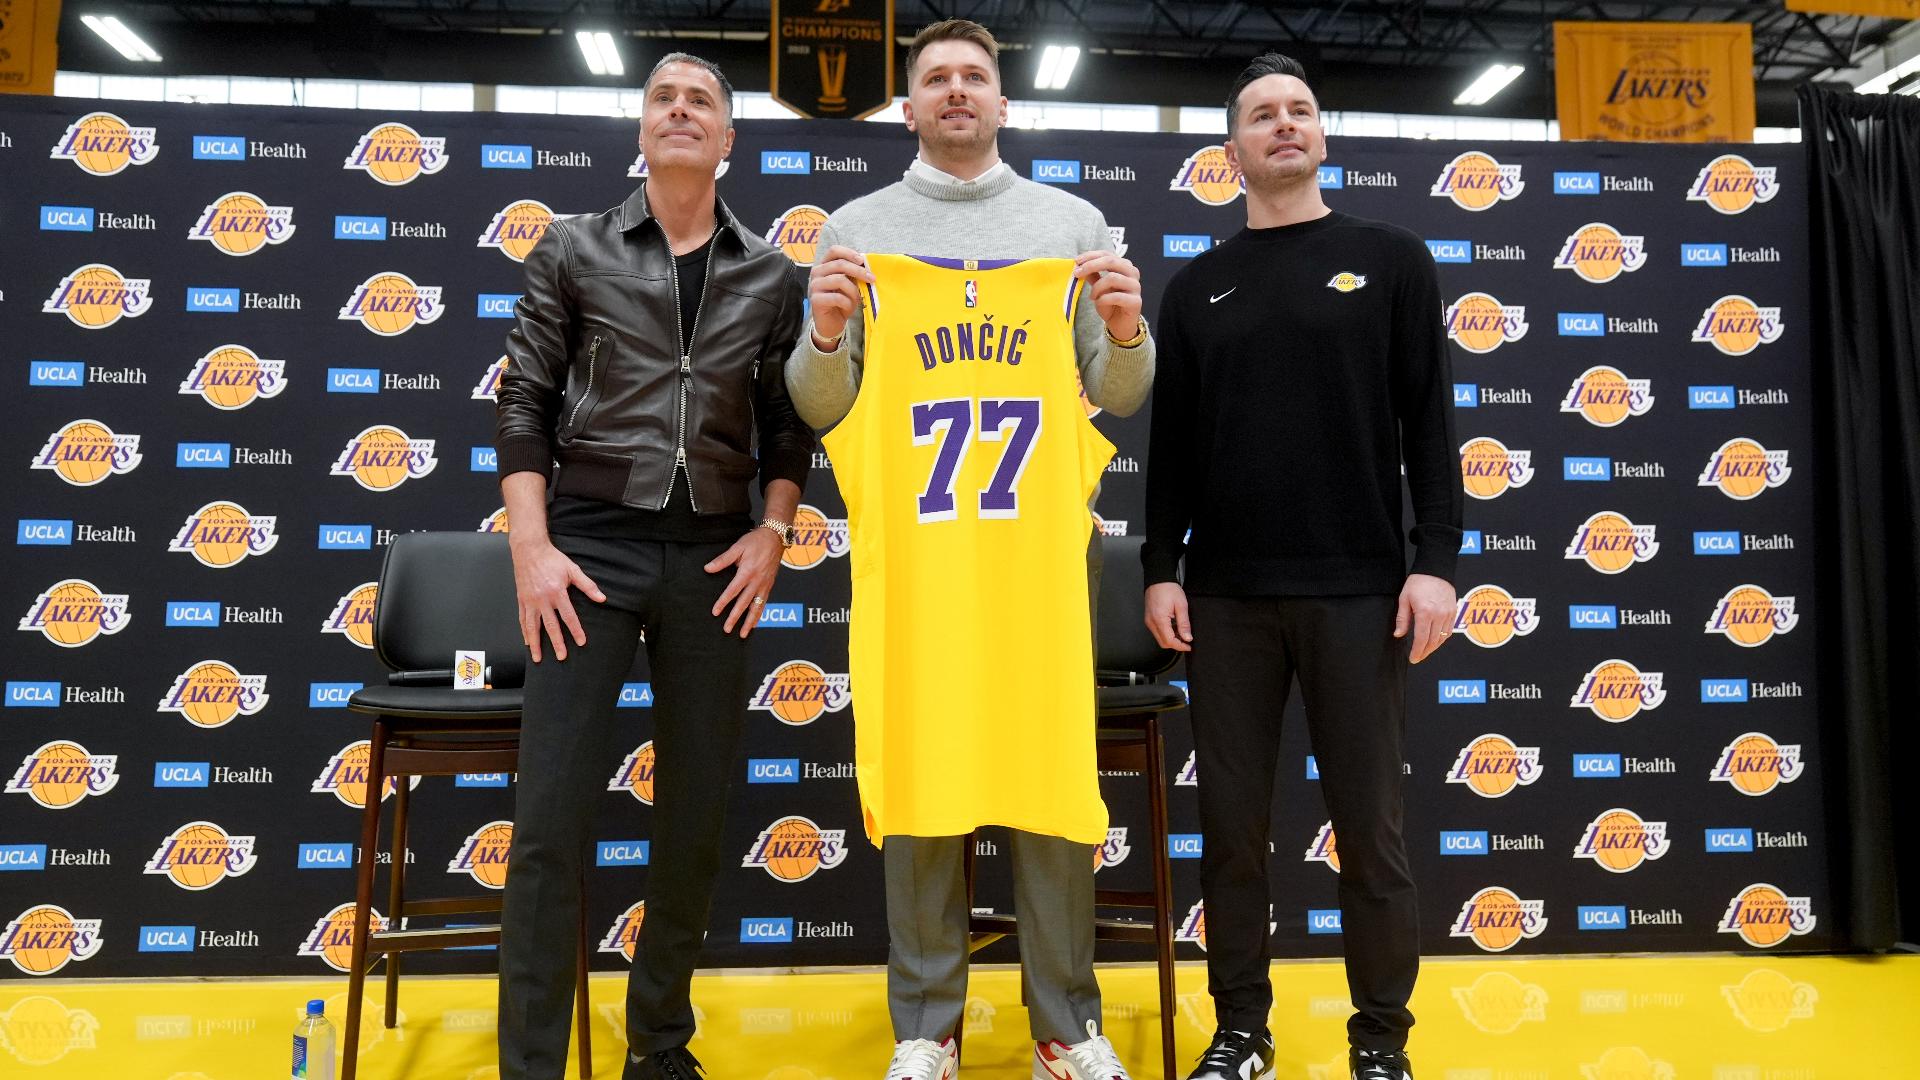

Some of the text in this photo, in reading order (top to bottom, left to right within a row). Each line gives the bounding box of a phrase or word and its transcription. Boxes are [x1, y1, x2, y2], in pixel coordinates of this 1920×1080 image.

[782, 24, 882, 41] CHAMPIONS
[1606, 69, 1710, 109] LAKERS
[61, 128, 150, 161] LAKERS
[201, 142, 306, 158] UCLA Health
[354, 138, 440, 170] LAKERS
[489, 151, 591, 167] UCLA Health
[768, 156, 867, 172] UCLA Health
[1039, 165, 1135, 180] UCLA Health
[1180, 161, 1245, 188] LAKER
[1347, 171, 1397, 186] Health
[1440, 167, 1516, 196] LAKERS
[1560, 176, 1653, 191] UCLA Health
[1695, 171, 1771, 198] LAKERS
[48, 213, 155, 229] UCLA Health
[198, 208, 286, 240] LAKERS
[342, 222, 446, 237] UCLA Health
[488, 216, 546, 244] LAKE
[771, 221, 819, 246] LAKE
[1170, 241, 1205, 253] UCLA
[1432, 245, 1525, 260] UCLA Health
[1562, 239, 1638, 268] LAKERS
[1688, 248, 1779, 262] UCLA Health
[53, 280, 144, 313] LAKERS
[194, 293, 300, 309] UCLA Health
[349, 288, 436, 320] LAKERS
[485, 300, 513, 312] UCL
[1447, 308, 1519, 338] LAKERS
[1565, 318, 1658, 333] UCLA Health
[1700, 311, 1775, 339] LAKERS
[914, 313, 1031, 371] DONČIĆ
[38, 367, 146, 383] UCLA Health
[189, 362, 278, 394] LAKERS
[335, 374, 440, 389] UCLA Health
[1481, 388, 1531, 403] Health
[1569, 382, 1645, 411] LAKERS
[1695, 389, 1788, 404] UCLA Health
[42, 436, 133, 470] LAKERS
[185, 448, 292, 464] UCLA Health
[340, 442, 429, 474] LAKERS
[910, 397, 1043, 524] 77
[1104, 457, 1139, 473] alth
[1570, 462, 1664, 477] UCLA Health
[1707, 455, 1783, 483] LAKERS
[26, 525, 135, 542] UCLA Health
[179, 518, 269, 551] LAKERS
[327, 531, 364, 543] UCLA
[793, 530, 845, 553] KERS
[1486, 535, 1535, 550] Health
[1574, 528, 1650, 558] LAKERS
[1700, 535, 1793, 550] UCLA Health
[29, 597, 122, 630] LAKERS
[174, 607, 282, 623] UCLA Health
[761, 607, 851, 622] UCLA Healt
[1454, 601, 1530, 632] LAKERS
[1576, 610, 1670, 624] UCLA Health
[1714, 602, 1790, 630] LAKERS
[14, 687, 124, 702] UCLA Health
[168, 678, 260, 710] LAKERS
[318, 689, 355, 701] UCLA
[622, 689, 648, 701] CLA
[760, 677, 843, 708] LAKERS
[1445, 684, 1541, 699] UCLA Health
[1580, 676, 1658, 706] LAKERS
[1708, 682, 1801, 697] UCLA Health
[756, 765, 792, 776] UCLA
[1455, 751, 1534, 781] LAKERS
[1580, 758, 1675, 772] UCLA Health
[1719, 749, 1795, 778] LAKERS
[16, 758, 110, 791] LAKERS
[163, 767, 272, 782] UCLA Health
[1175, 840, 1201, 852] UCL
[1447, 835, 1544, 850] UCLA Health
[1583, 826, 1661, 856] LAKERS
[1712, 832, 1807, 847] UCLA Health
[0, 849, 110, 865] UCLA Health
[155, 840, 248, 872] LAKERS
[306, 850, 344, 862] UCLA
[605, 848, 641, 859] UCLA
[752, 834, 839, 865] LAKERS
[1315, 916, 1340, 928] UCL
[1459, 904, 1538, 934] LAKERS
[1585, 910, 1682, 924] UCLA Health
[1727, 901, 1806, 931] LAKERS
[749, 922, 853, 937] UCLA Health
[0, 923, 94, 956] LAKERS
[147, 931, 258, 946] UCLA Health
